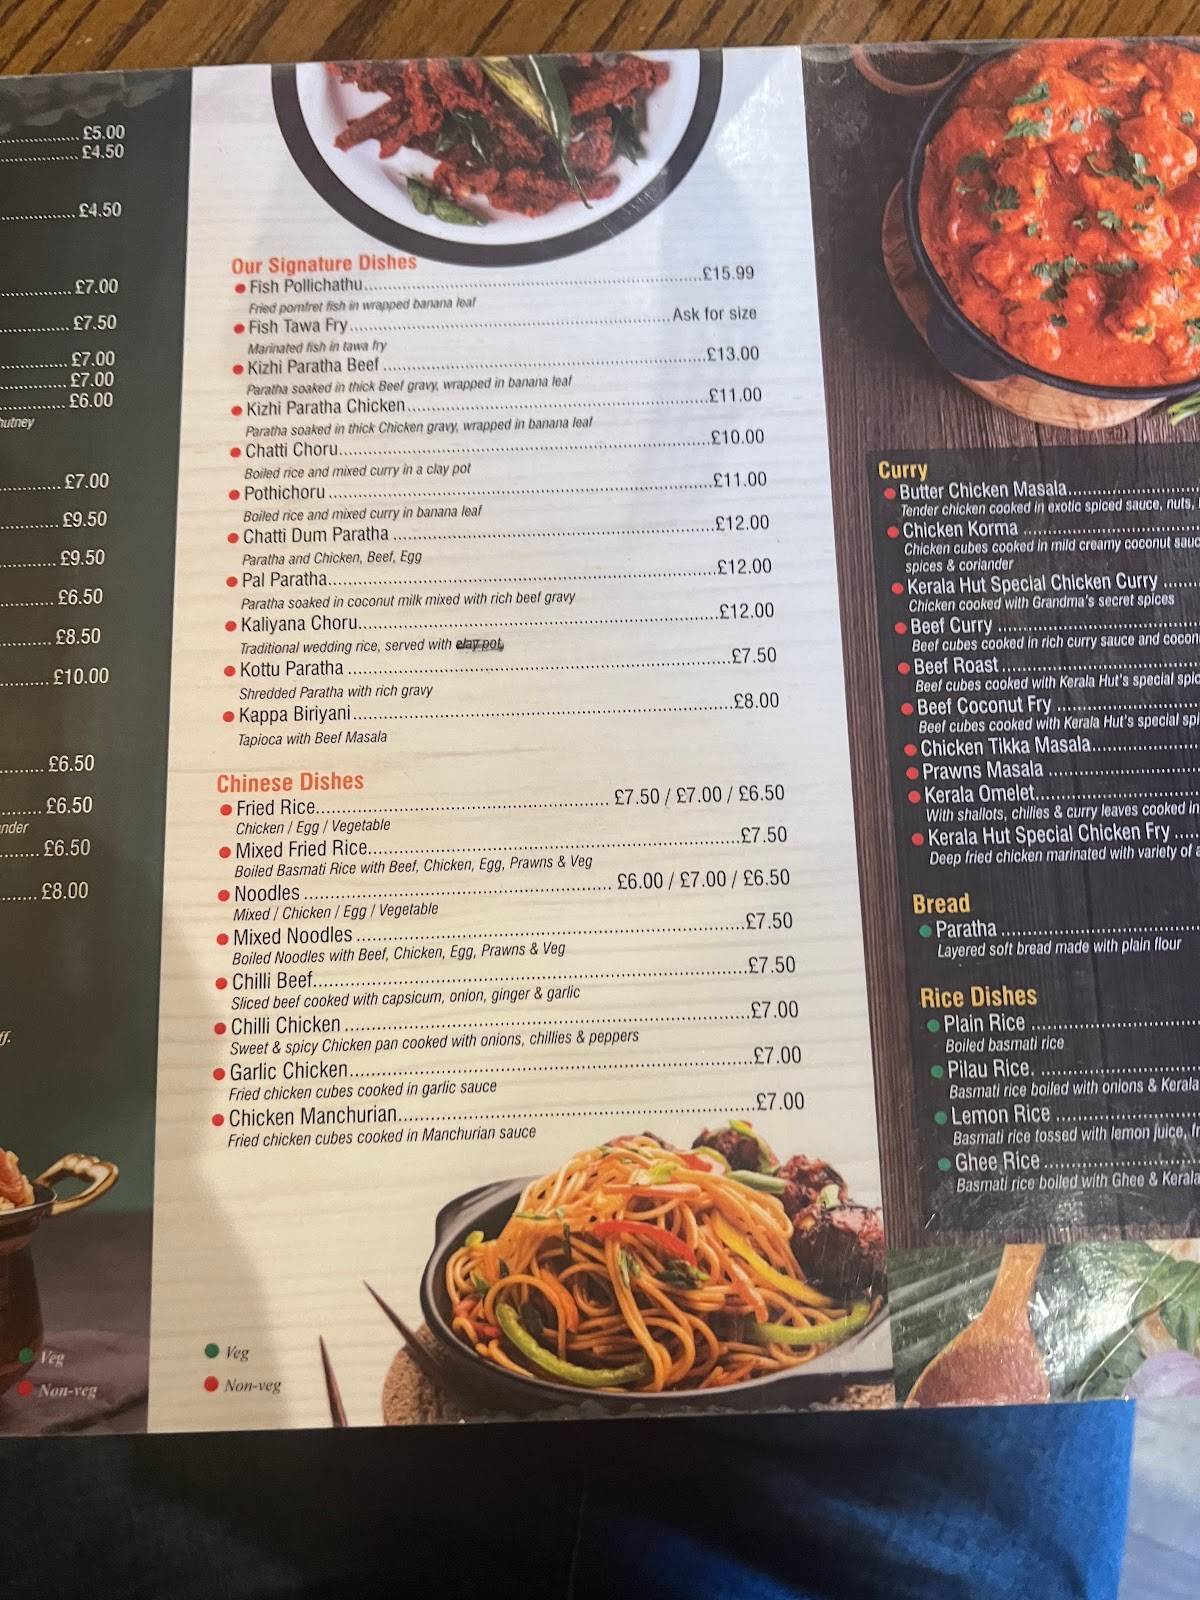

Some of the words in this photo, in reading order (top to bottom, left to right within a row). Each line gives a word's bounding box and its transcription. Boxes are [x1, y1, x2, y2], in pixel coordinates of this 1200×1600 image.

[84, 125, 125, 140] £5.00
[83, 144, 124, 159] £4.50
[79, 202, 121, 217] £4.50
[232, 259, 262, 274] Our
[269, 257, 352, 276] Signature
[360, 254, 416, 270] Dishes
[76, 279, 118, 294] £7.00
[251, 280, 278, 293] Fish
[285, 277, 362, 292] Pollichathu
[703, 266, 754, 280] £15.99
[74, 315, 116, 330] £7.50
[250, 320, 277, 334] Fish
[284, 319, 320, 333] Tawa
[326, 318, 347, 334] Fry
[673, 307, 699, 321] Ask
[705, 307, 722, 320] for
[730, 307, 756, 320] size
[72, 351, 114, 366] £7.00
[248, 360, 282, 375] Kizhi
[288, 359, 341, 373] Paratha
[348, 357, 378, 371] Beef
[707, 346, 759, 361] £13.00
[71, 372, 114, 387] £7.00
[70, 392, 113, 408] £6.00
[248, 402, 280, 416] Kizhi
[287, 400, 341, 415] Paratha
[347, 398, 404, 413] Chicken
[710, 388, 761, 402] £11.00
[246, 444, 287, 458] Chatti
[294, 442, 337, 456] Choru
[712, 429, 764, 444] £10.00
[879, 461, 927, 481] Curry
[65, 473, 109, 489] £7.00
[245, 485, 324, 500] Pothichoru
[714, 472, 766, 487] £11.00
[900, 484, 944, 499] Butter
[949, 482, 1008, 498] Chicken
[1014, 480, 1067, 496] Masala
[63, 511, 107, 527] £9.50
[244, 529, 285, 544] Chatti
[292, 528, 326, 542] Dum
[333, 526, 388, 541] Paratha
[716, 515, 769, 530] £12.00
[904, 522, 963, 538] Chicken
[968, 521, 1018, 536] Korma
[61, 549, 104, 565] £9.50
[243, 573, 264, 587] Pal
[271, 571, 327, 586] Paratha
[718, 558, 771, 574] £12.00
[908, 578, 954, 594] Kerala
[960, 577, 986, 593] Hut
[991, 575, 1045, 595] Special
[1051, 574, 1111, 590] Chicken
[1116, 572, 1157, 591] Curry
[58, 588, 102, 605] £6.50
[242, 617, 305, 634] Kaliyana
[312, 615, 356, 630] Choru
[720, 603, 773, 619] £12.00
[911, 617, 944, 634] Beef
[950, 617, 992, 635] Curry
[56, 628, 100, 644] £8.50
[241, 662, 279, 677] Kottu
[287, 660, 343, 675] Paratha
[732, 647, 776, 664] £7.50
[915, 658, 947, 674] Beef
[954, 657, 998, 673] Roast
[54, 668, 108, 684] £10.00
[240, 687, 296, 700] Shredded
[300, 686, 343, 698] Paratha
[348, 685, 371, 697] with
[376, 685, 397, 696] rich
[401, 686, 433, 698] gravy
[240, 708, 287, 725] Kappa
[295, 706, 350, 724] Biriyani
[735, 692, 778, 708] £8.00
[918, 698, 951, 715] Beef
[958, 697, 1023, 714] Coconut
[1028, 695, 1051, 715] Fry
[240, 734, 282, 748] Tapioca
[287, 732, 310, 744] with
[315, 732, 342, 743] Beef
[346, 731, 387, 743] Masala
[921, 739, 983, 756] Chicken
[988, 737, 1030, 754] Tikka
[1035, 736, 1091, 753] Masala
[49, 755, 94, 772] £6.50
[923, 763, 981, 780] Prawns
[987, 760, 1043, 778] Masala
[218, 774, 292, 793] Chinese
[301, 772, 363, 790] Dishes
[238, 800, 274, 816] Fried
[281, 799, 314, 814] Rice
[615, 788, 659, 805] £7.50
[677, 787, 721, 803] £7.00
[739, 785, 784, 801] £6.50
[925, 786, 974, 803] Kerala
[979, 784, 1035, 802] Omelet
[47, 797, 92, 813] £6.50
[0, 821, 29, 833] nder
[236, 823, 284, 835] Chicken
[297, 821, 319, 835] Egg
[333, 819, 390, 834] Vegetable
[929, 828, 977, 846] Kerala
[983, 827, 1010, 844] Hut
[1016, 825, 1072, 847] Special
[1079, 823, 1140, 841] Chicken
[1146, 822, 1169, 842] Fry
[44, 839, 90, 856] £6.50
[237, 842, 282, 858] Mixed
[290, 840, 326, 856] Fried
[333, 840, 366, 855] Rice
[742, 826, 787, 843] £7.50
[42, 882, 88, 899] £8.00
[236, 885, 299, 901] Noodles
[618, 873, 662, 889] £6.00
[681, 871, 726, 887] £7.00
[744, 869, 789, 886] £6.50
[913, 893, 970, 913] Bread
[235, 928, 280, 945] Mixed
[288, 926, 352, 944] Noodles
[746, 912, 792, 929] £7.50
[937, 920, 997, 937] Paratha
[233, 973, 270, 990] Chilli
[278, 971, 312, 988] Beef
[749, 956, 795, 973] £7.50
[921, 988, 963, 1008] Rice
[971, 986, 1037, 1006] Dishes
[232, 1018, 269, 1035] Chilli
[277, 1016, 339, 1033] Chicken
[752, 1001, 798, 1018] £7.00
[945, 1014, 983, 1032] Plain
[990, 1013, 1025, 1031] Rice
[946, 1038, 984, 1052] Boiled
[989, 1036, 1037, 1051] basmati
[1042, 1035, 1064, 1049] rice
[231, 1063, 276, 1080] Garlic
[284, 1061, 347, 1079] Chicken
[754, 1046, 801, 1064] £7.00
[948, 1060, 987, 1078] Pilau
[230, 1109, 293, 1127] Chicken
[301, 1106, 396, 1124] Manchurian
[757, 1092, 804, 1110] £7.00
[952, 1107, 1008, 1124] Lemon
[1014, 1104, 1050, 1122] Rice
[956, 1153, 997, 1171] Ghee
[1003, 1151, 1039, 1170] Rice
[42, 1351, 64, 1367] Veg
[227, 1346, 249, 1361] Veg
[40, 1385, 97, 1399] Non-veg
[225, 1379, 281, 1394] Non-veg
